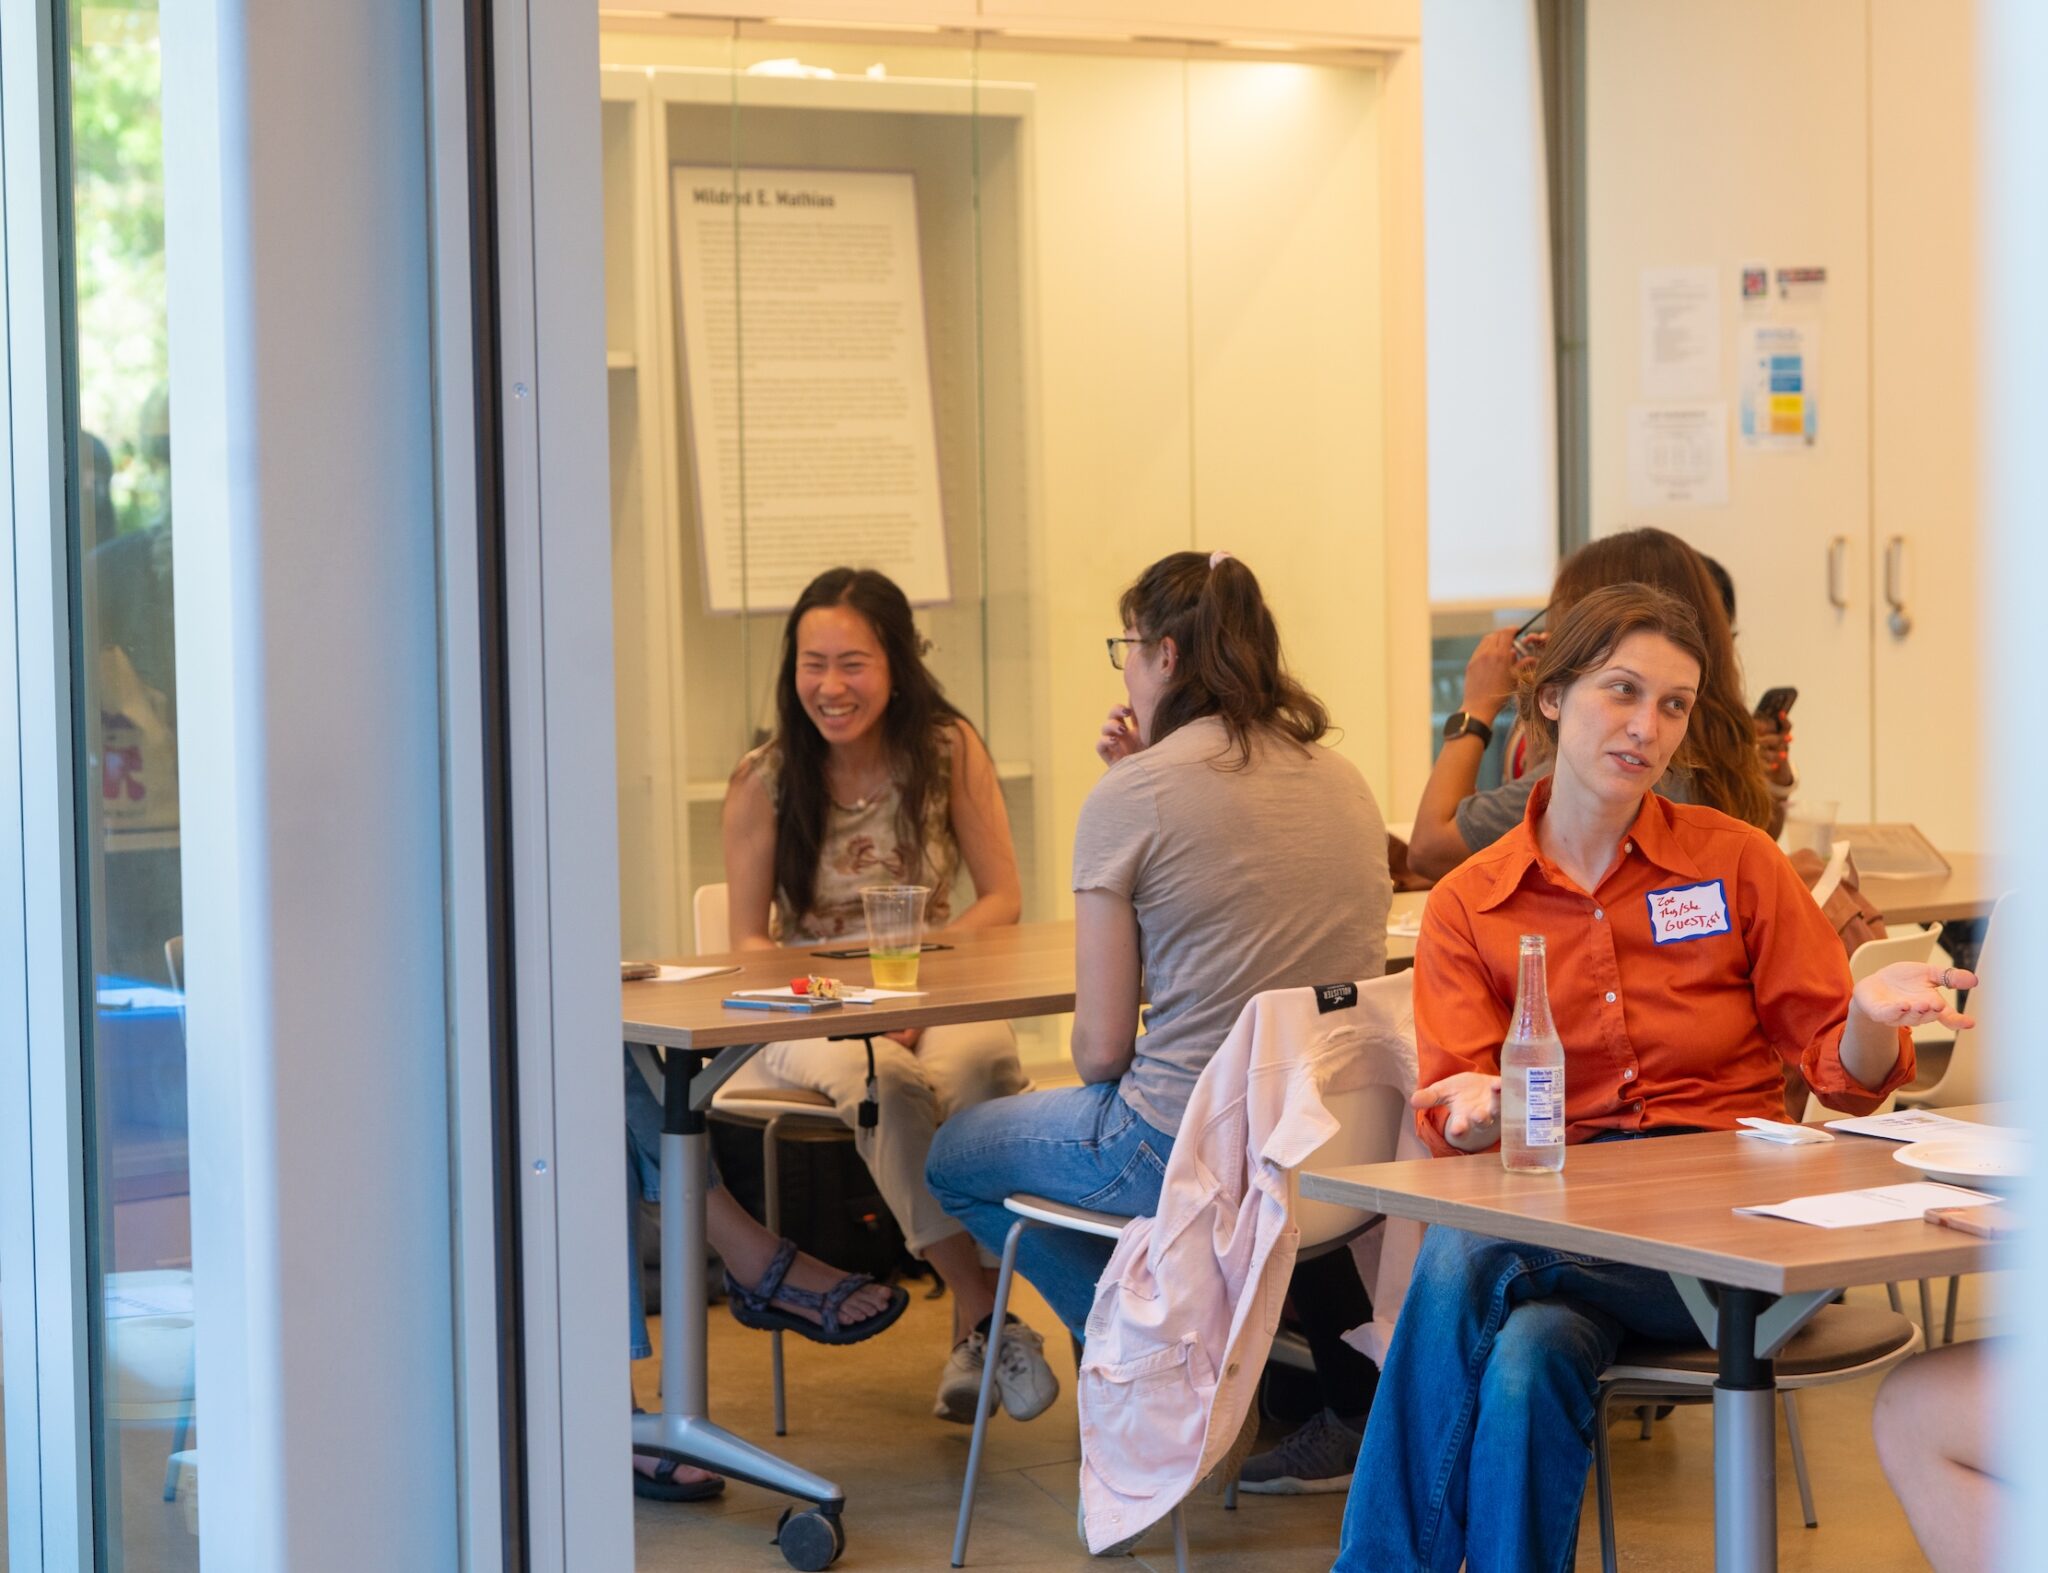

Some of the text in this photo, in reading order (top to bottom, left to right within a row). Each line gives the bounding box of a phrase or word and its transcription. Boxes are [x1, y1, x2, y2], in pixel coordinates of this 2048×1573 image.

[757, 189, 770, 206] E.
[776, 190, 835, 207] Mathias
[1657, 897, 1675, 907] Zoe
[1323, 986, 1352, 999] HOLLISTER
